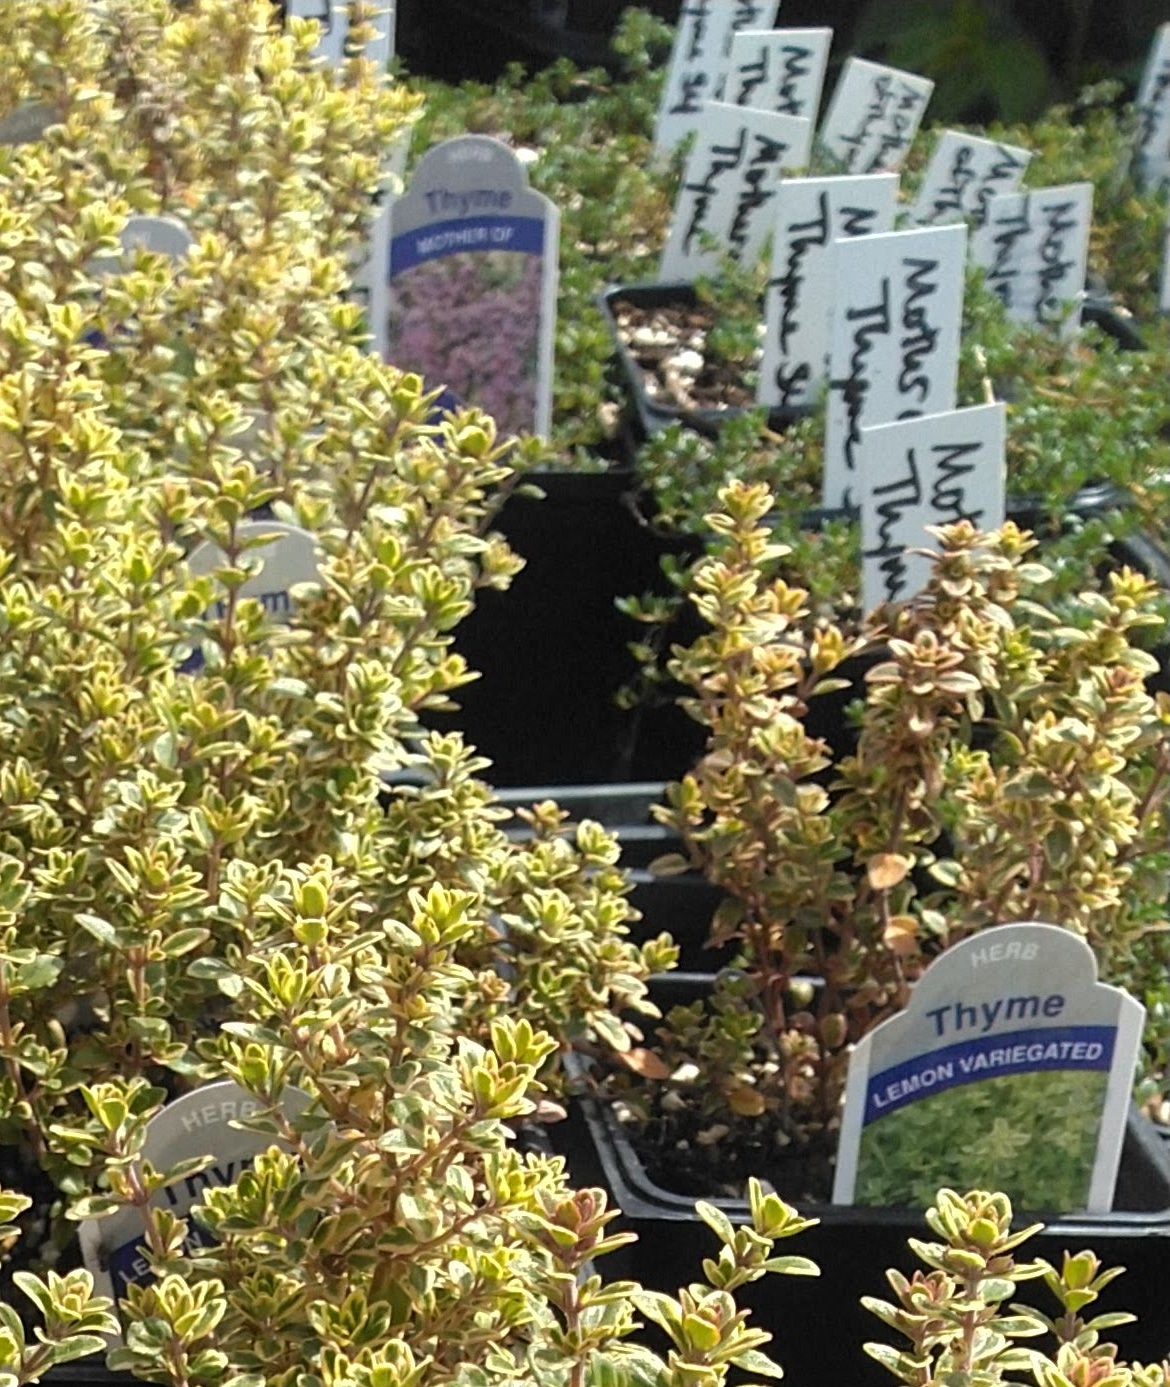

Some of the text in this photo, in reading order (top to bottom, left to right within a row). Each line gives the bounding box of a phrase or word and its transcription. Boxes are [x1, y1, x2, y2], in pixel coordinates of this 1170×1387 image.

[416, 227, 514, 253] MOTHER OF
[971, 941, 1039, 968] HERB
[926, 993, 1066, 1036] Thyme
[873, 1041, 1104, 1109] LEMON VARIEGATED
